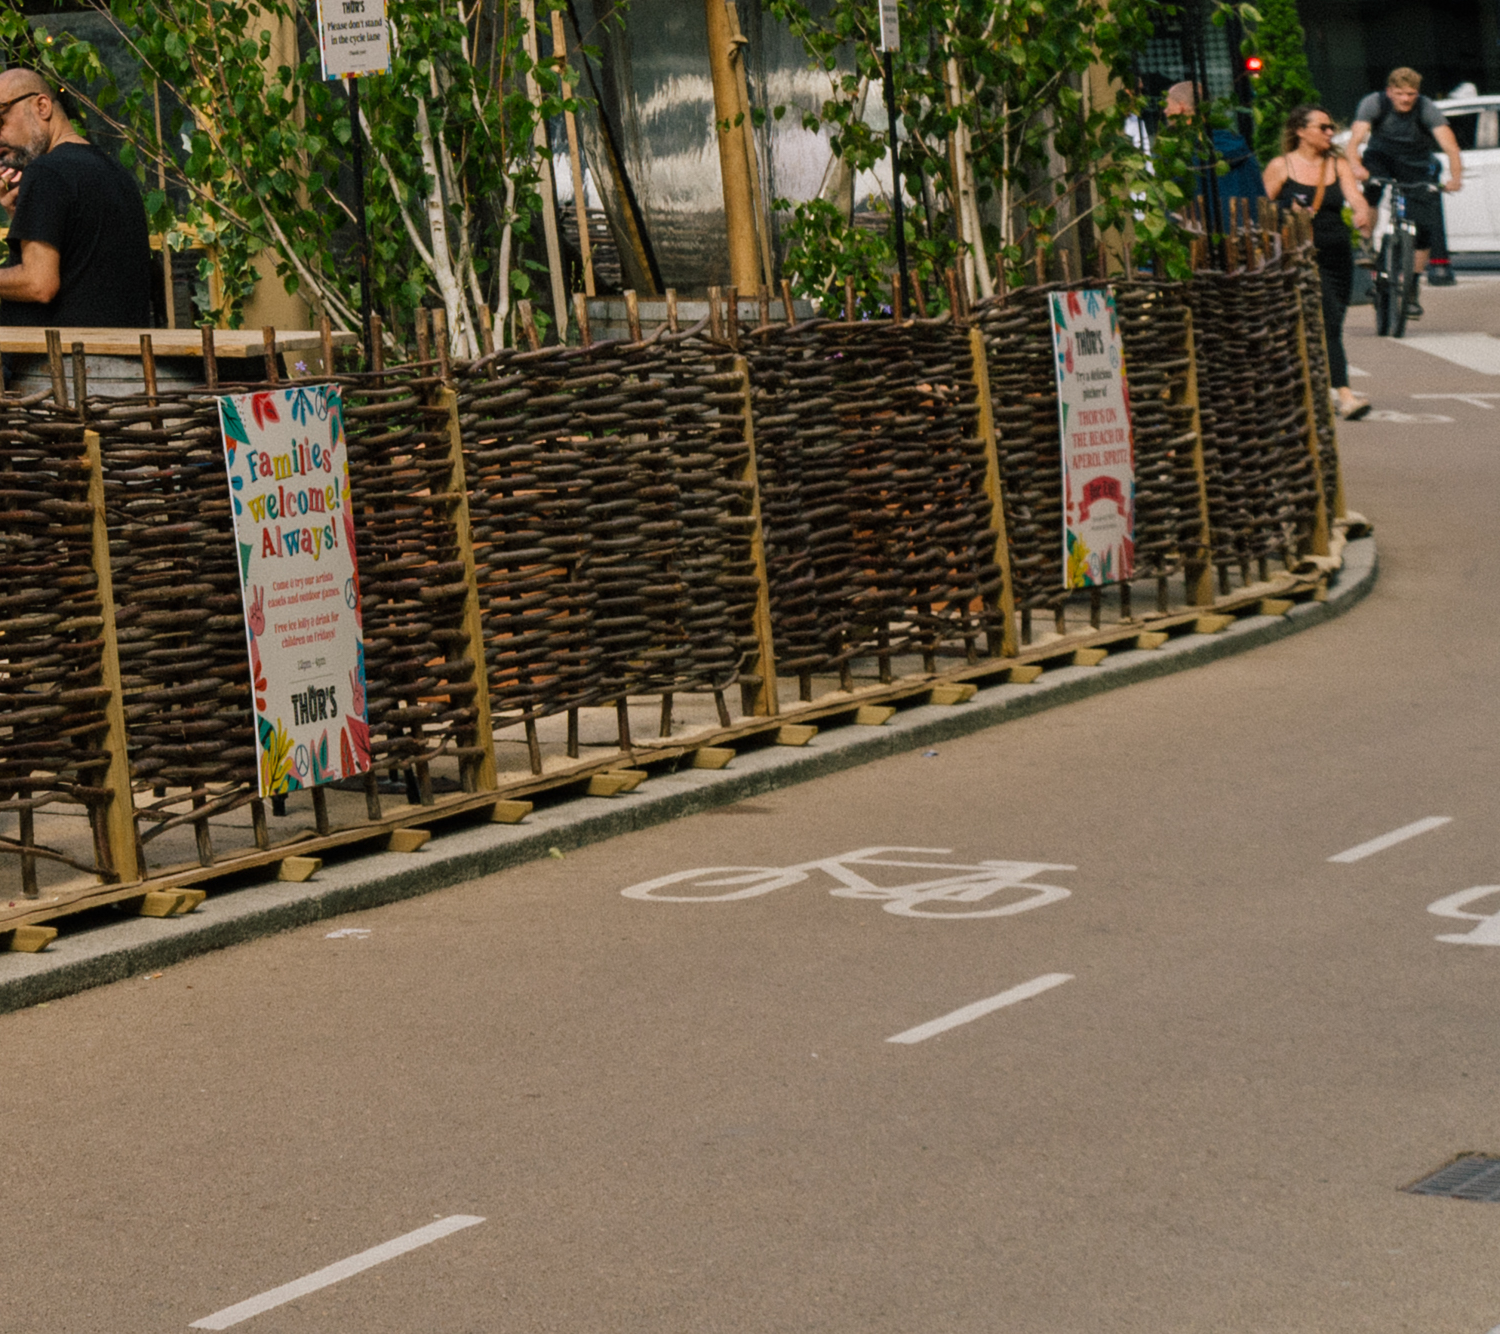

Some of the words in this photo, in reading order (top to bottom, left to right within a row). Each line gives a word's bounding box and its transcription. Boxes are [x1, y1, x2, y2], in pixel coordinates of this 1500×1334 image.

[342, 0, 365, 14] THOR'S
[327, 22, 347, 31] Please
[349, 20, 364, 29] don't
[365, 17, 382, 27] stand
[331, 35, 337, 45] in
[339, 35, 348, 43] the
[349, 33, 365, 45] cycle
[367, 32, 380, 41] lane
[246, 436, 332, 482] Families
[247, 476, 340, 523] welcome!
[262, 516, 338, 561] Always!
[273, 580, 290, 591] Come
[288, 593, 299, 605] and
[275, 620, 288, 634] Free
[289, 619, 298, 631] ice
[316, 613, 330, 627] drink
[331, 612, 339, 623] for
[282, 636, 306, 648] children
[307, 635, 314, 644] on
[291, 685, 338, 726] THOR'S
